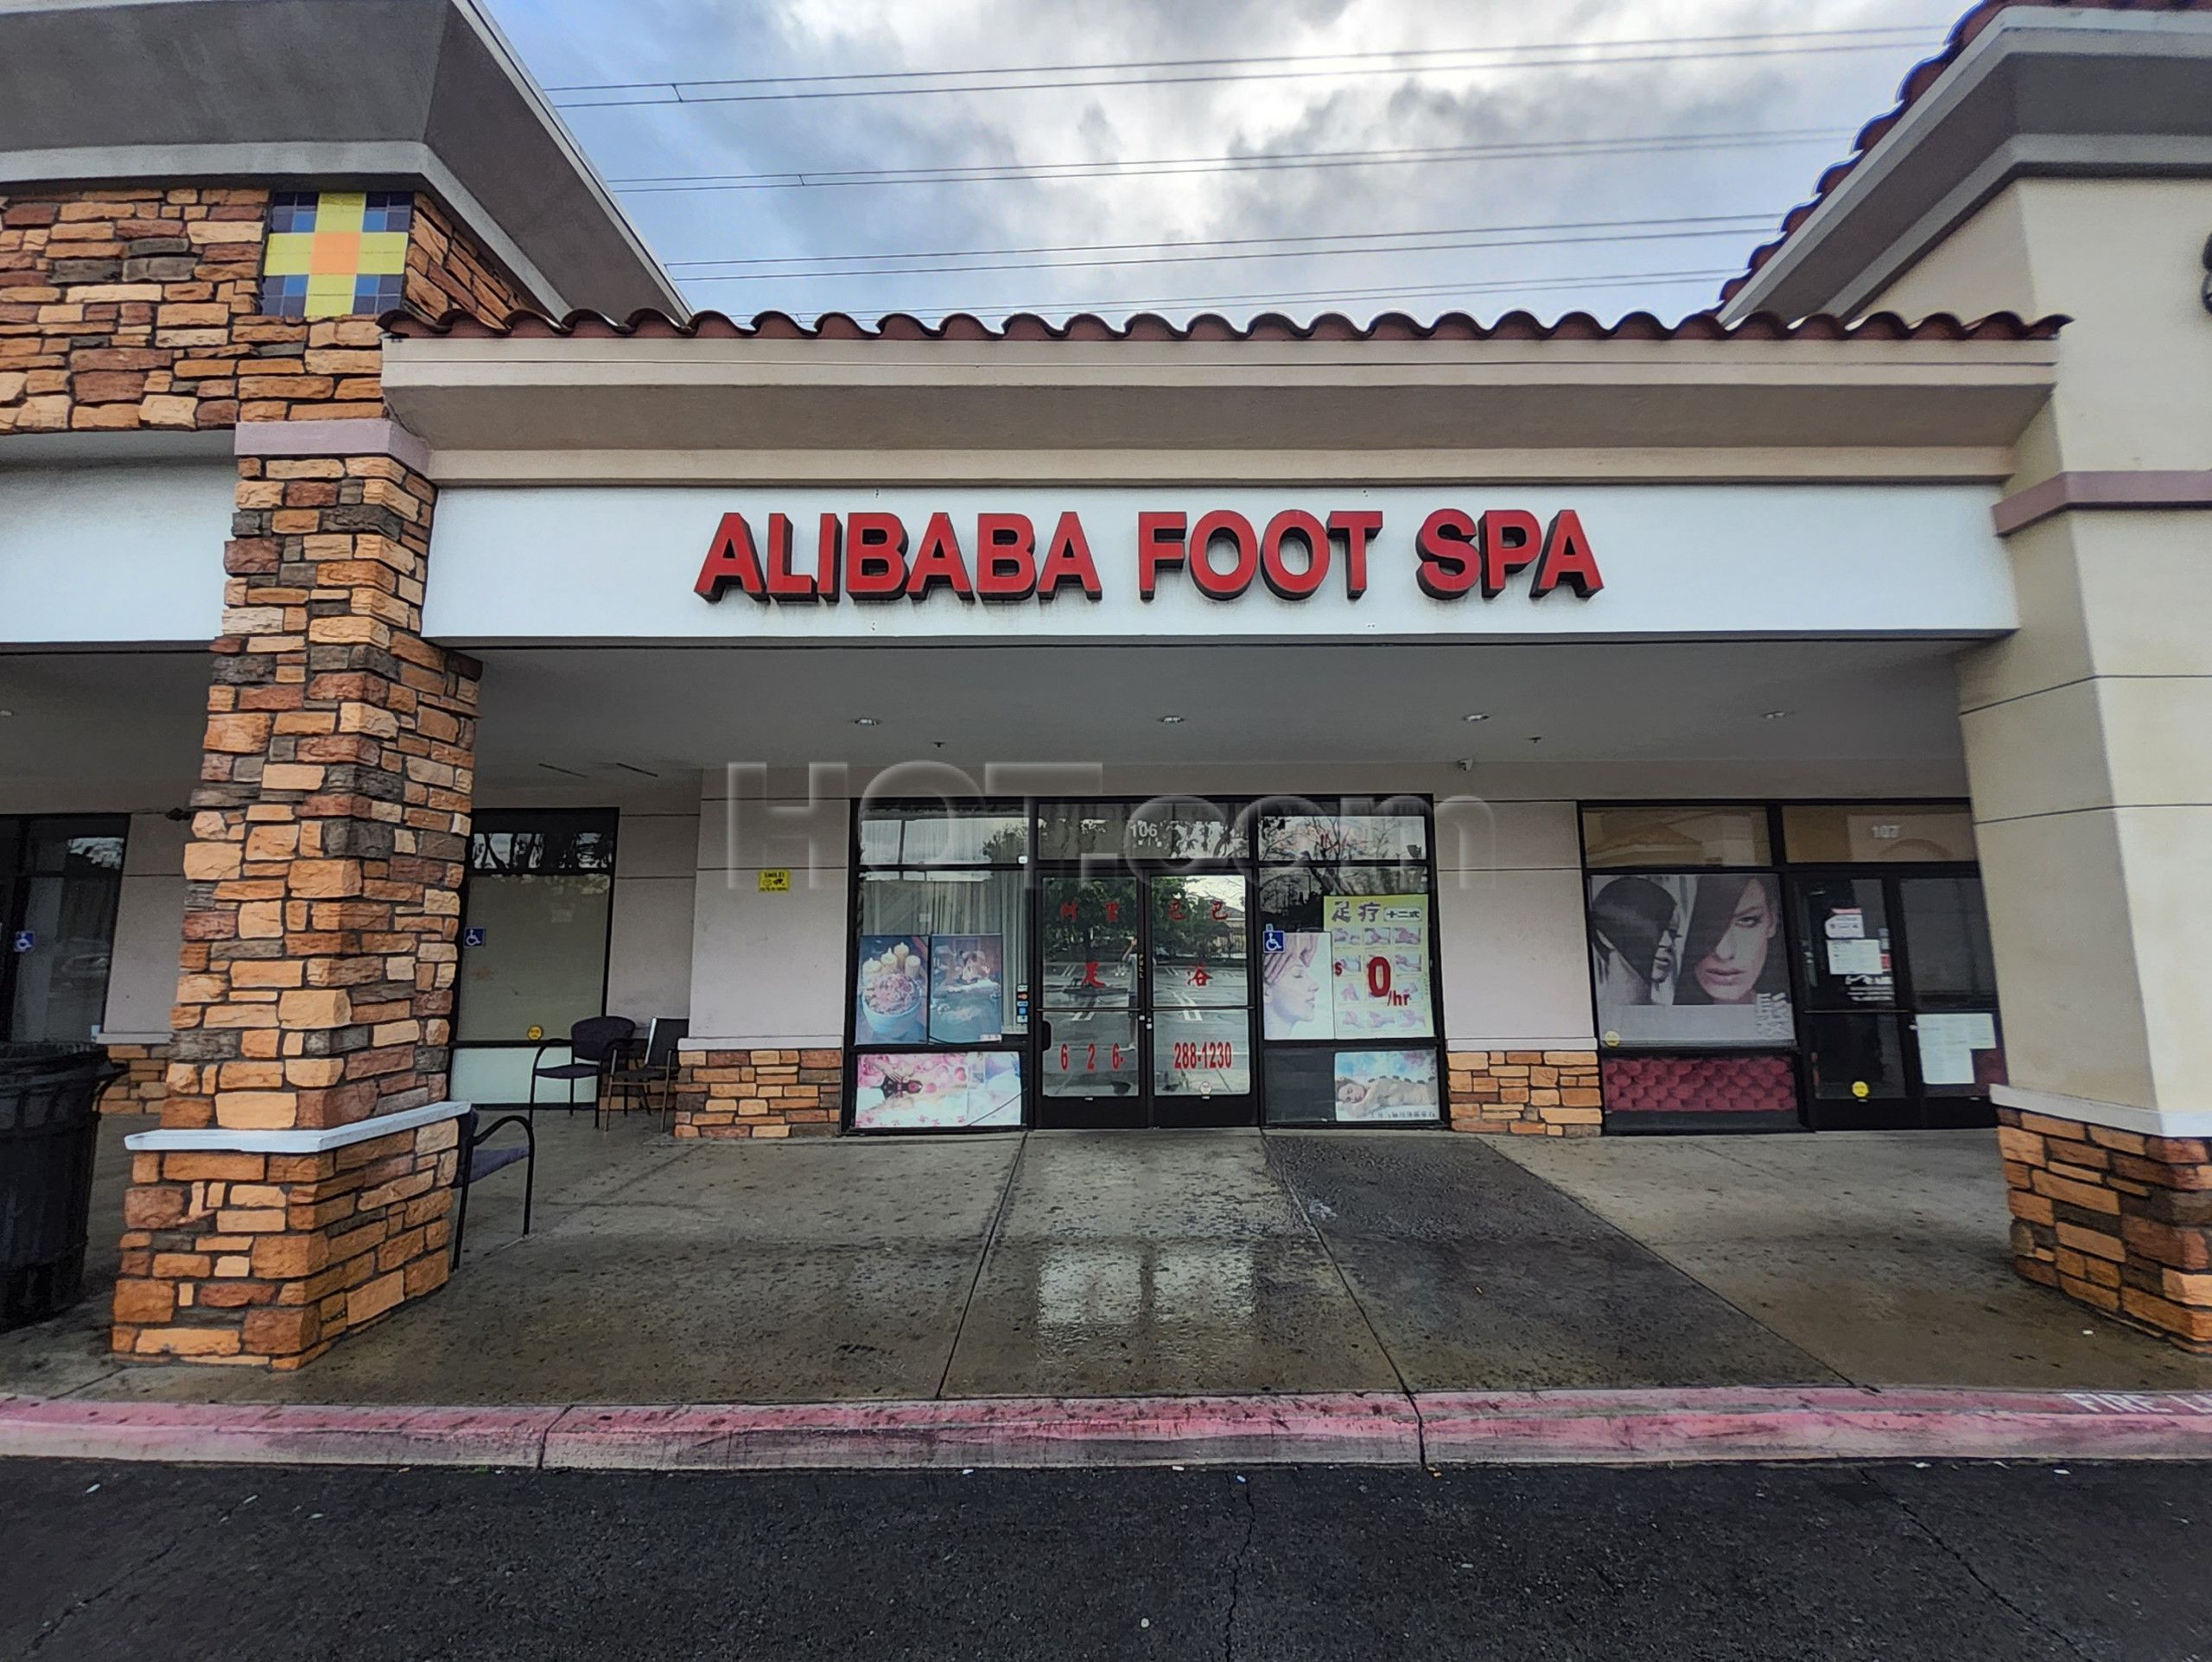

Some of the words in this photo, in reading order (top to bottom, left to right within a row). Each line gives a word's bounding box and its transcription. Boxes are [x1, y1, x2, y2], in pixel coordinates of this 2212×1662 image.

[693, 512, 1103, 605] ALIBABA
[1139, 510, 1382, 601] FOOT
[1415, 508, 1605, 600] SPA
[1130, 823, 1158, 837] 106
[1173, 1041, 1232, 1070] 288-1230
[2062, 1393, 2173, 1413] FIRE
